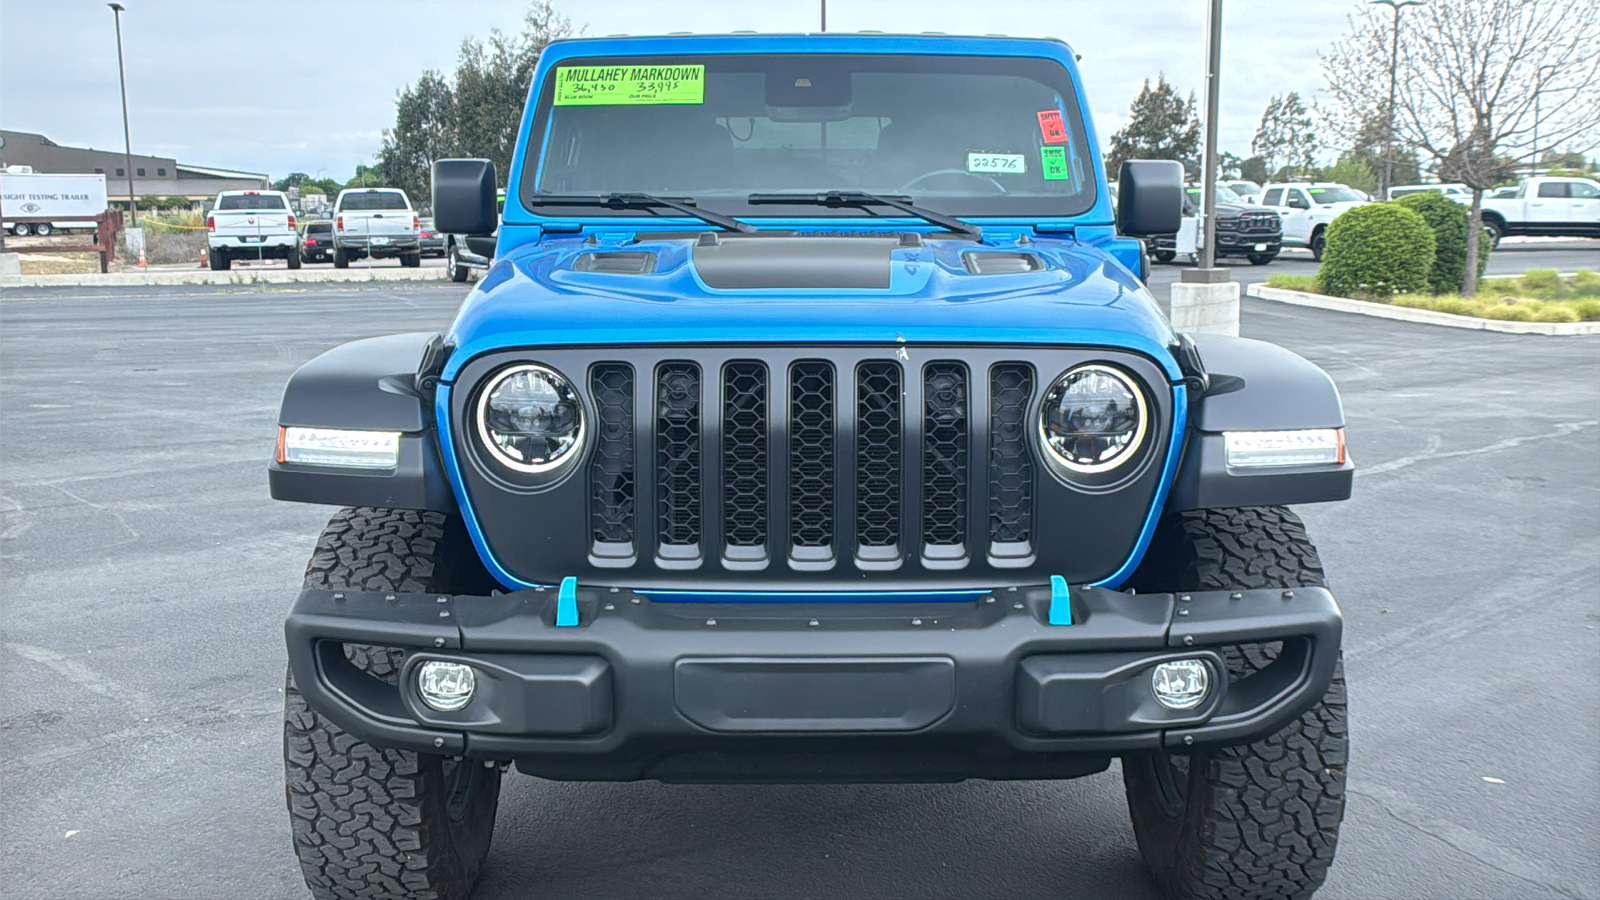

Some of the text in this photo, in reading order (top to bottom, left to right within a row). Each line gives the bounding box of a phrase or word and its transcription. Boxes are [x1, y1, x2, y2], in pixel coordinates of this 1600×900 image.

[565, 67, 700, 82] MULLAHEY MARKDOWN
[637, 81, 680, 94] 33,995
[1040, 112, 1060, 121] SAFETY
[1049, 129, 1060, 137] OK
[973, 157, 1018, 170] 22576
[1049, 165, 1061, 174] OK
